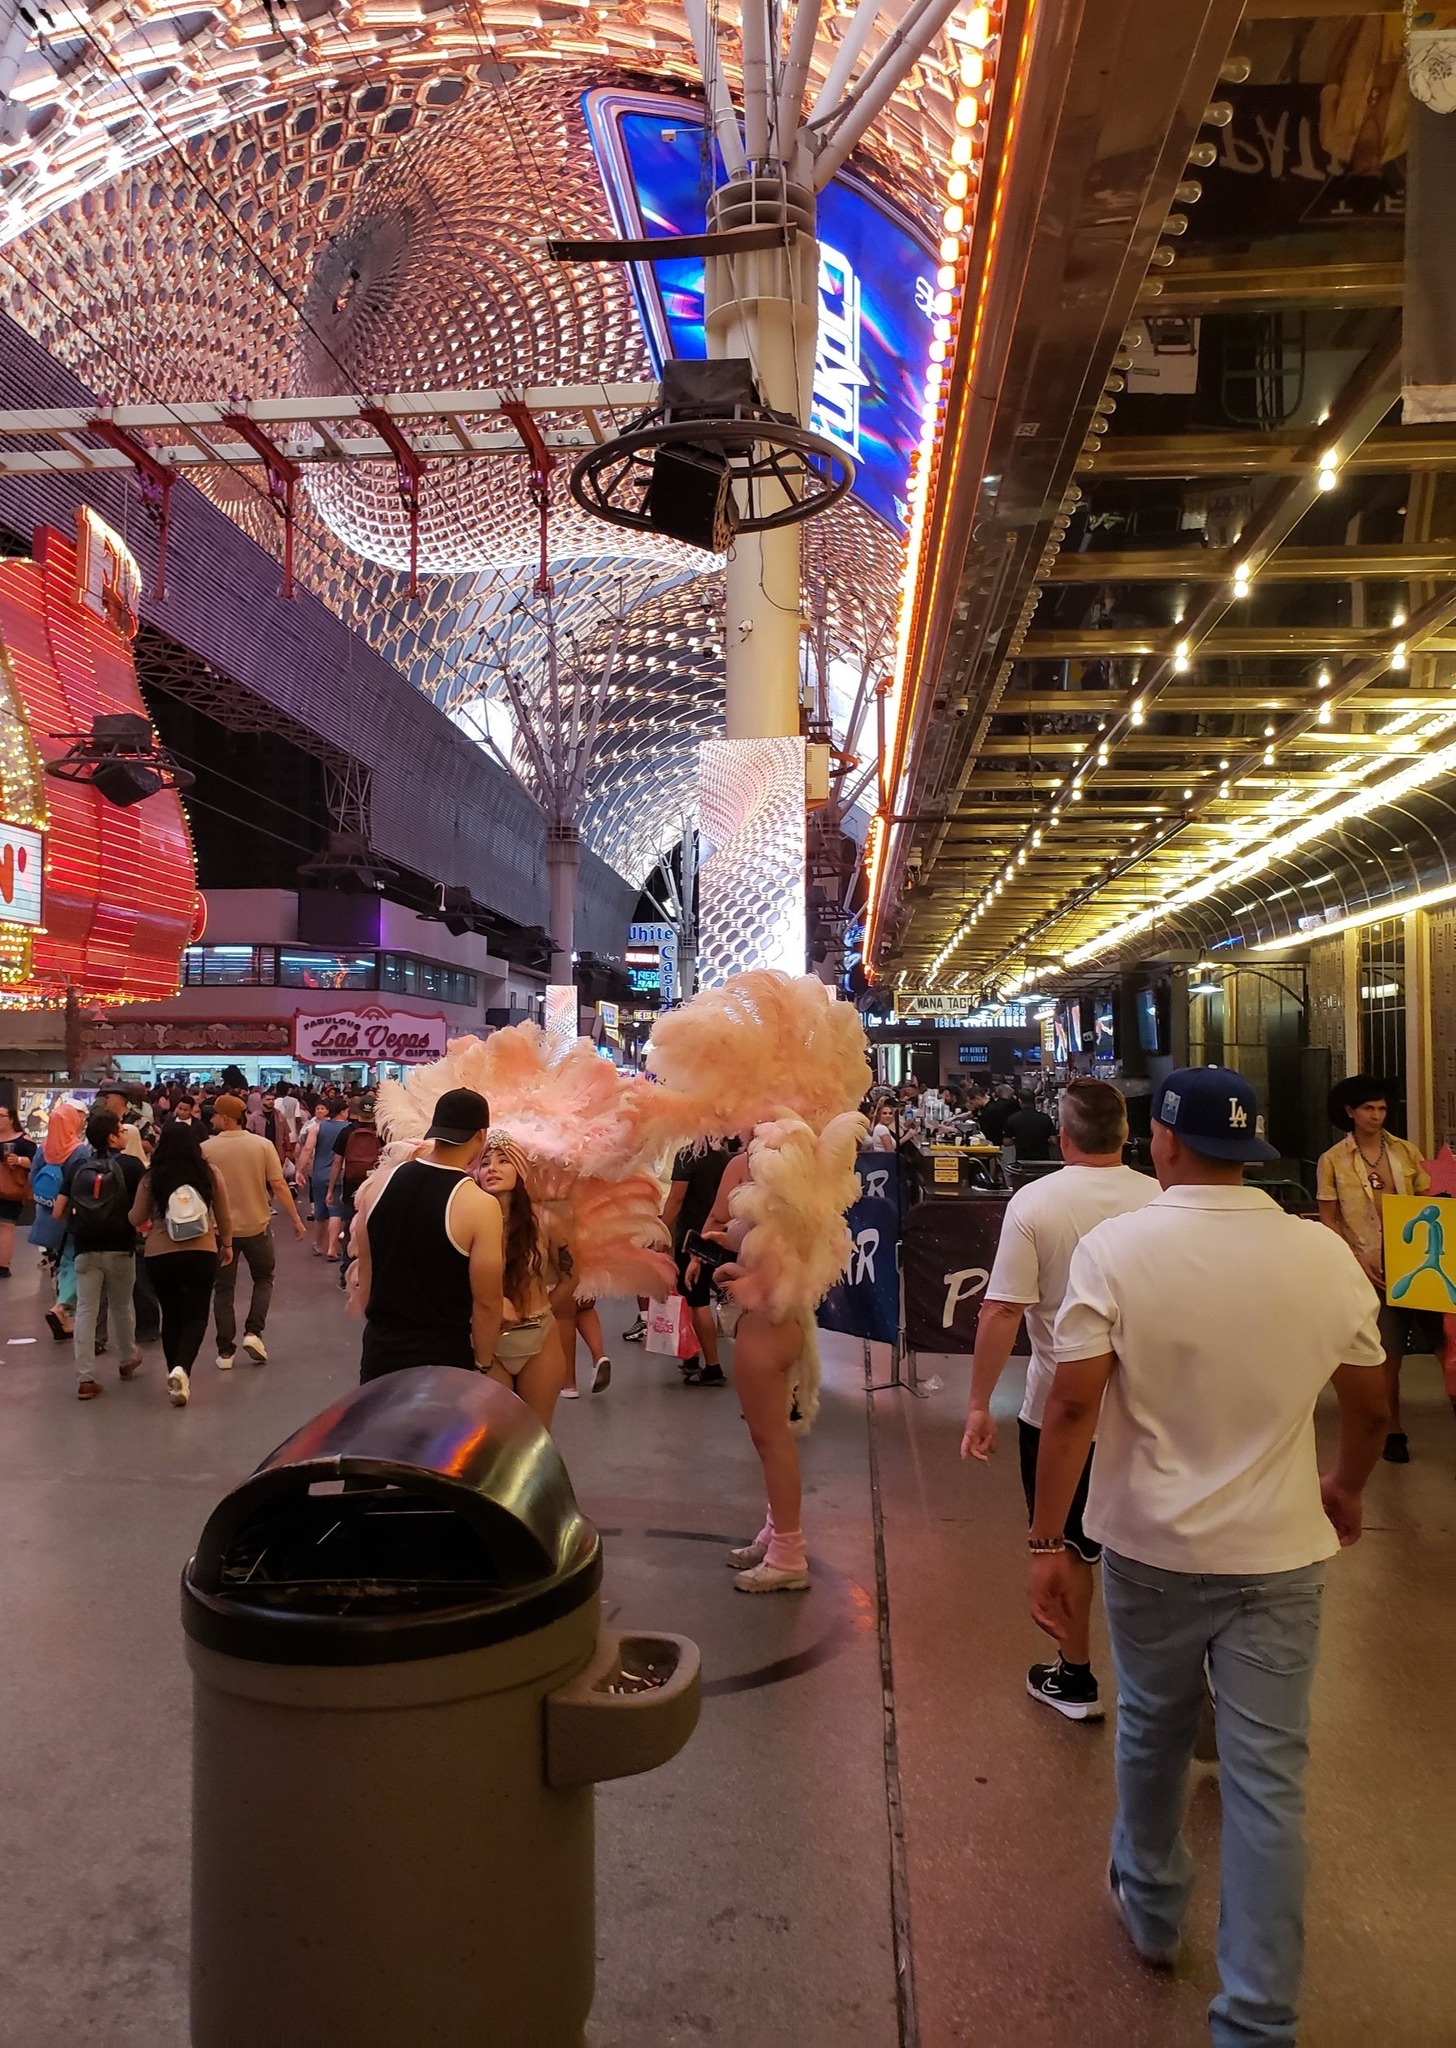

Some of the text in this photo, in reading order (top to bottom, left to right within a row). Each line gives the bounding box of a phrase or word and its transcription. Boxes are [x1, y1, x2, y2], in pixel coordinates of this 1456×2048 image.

[303, 1017, 361, 1031] FABULOUS
[934, 1017, 961, 1028] TESLA
[312, 1025, 430, 1056] Las Vegas
[312, 1048, 440, 1058] JEWELRY & GIFTS
[1228, 1097, 1248, 1128] LA
